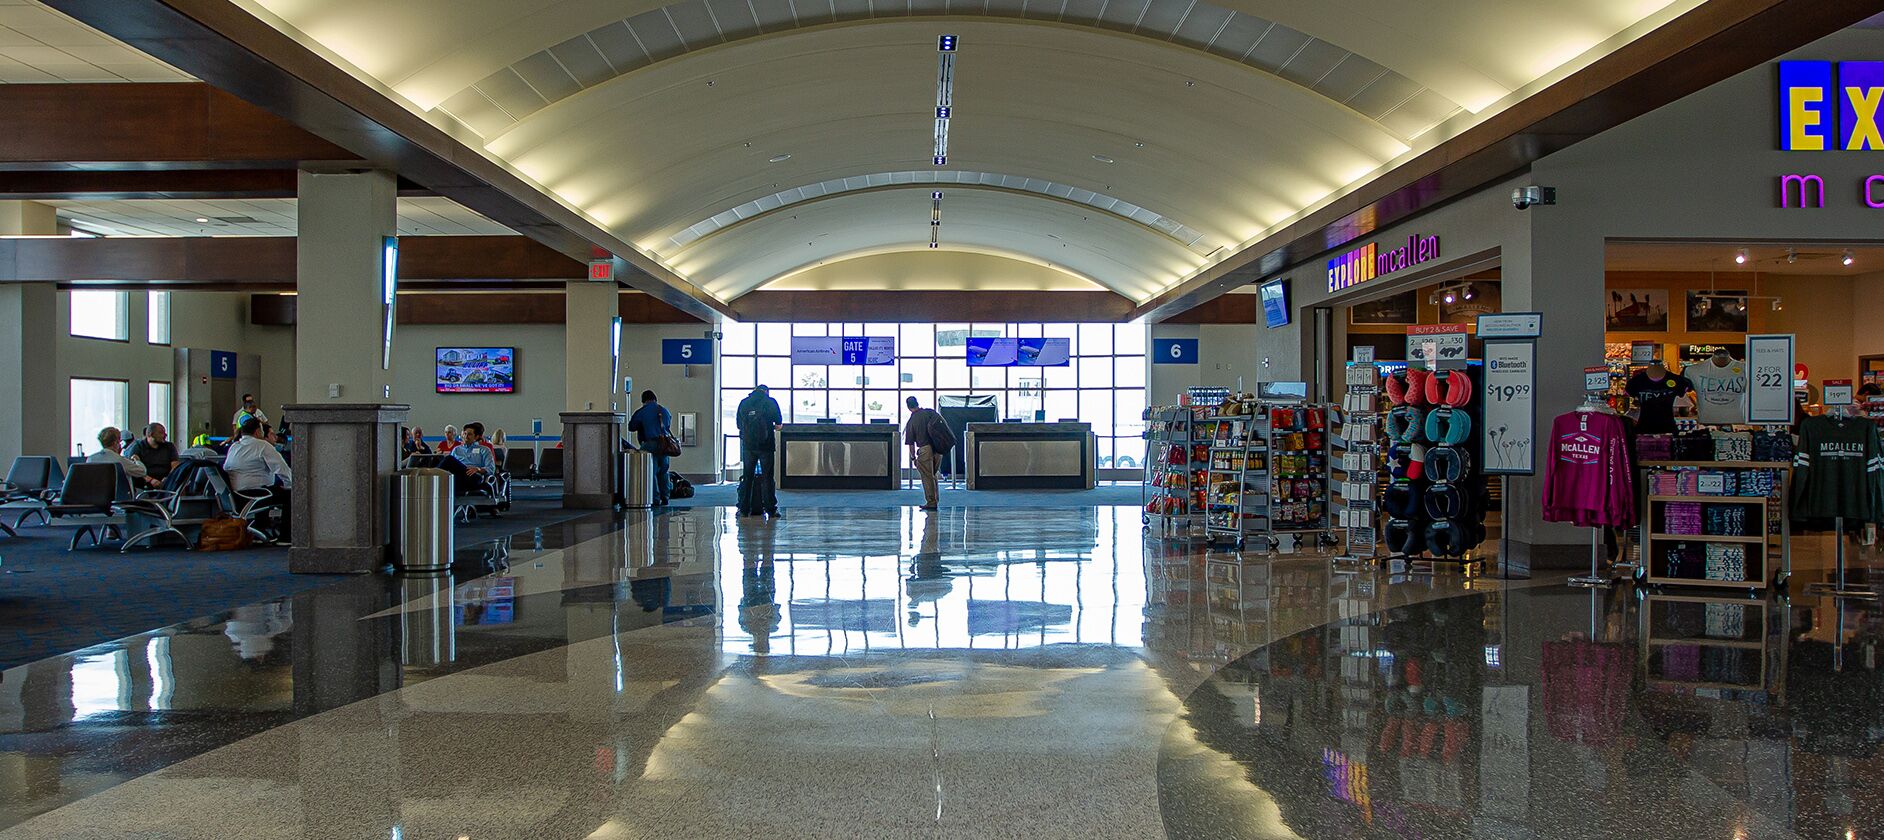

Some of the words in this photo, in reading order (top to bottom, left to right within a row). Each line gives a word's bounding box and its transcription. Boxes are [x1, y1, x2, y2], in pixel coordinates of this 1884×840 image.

[1789, 86, 1884, 150] EX
[1328, 253, 1375, 293] EXPLORE
[1378, 234, 1438, 276] mcallen
[592, 264, 610, 278] EXIT
[681, 344, 692, 359] 5
[844, 341, 863, 351] GATE
[1170, 343, 1182, 358] 6
[221, 357, 228, 372] 5
[850, 353, 856, 363] 5
[1498, 361, 1527, 369] Bluetooth
[1757, 366, 1763, 374] 2
[1764, 366, 1781, 374] FOR
[1587, 378, 1593, 386] 2
[1700, 375, 1744, 393] TEXAS
[1756, 373, 1782, 387] $22
[1820, 442, 1864, 452] MCALLEN
